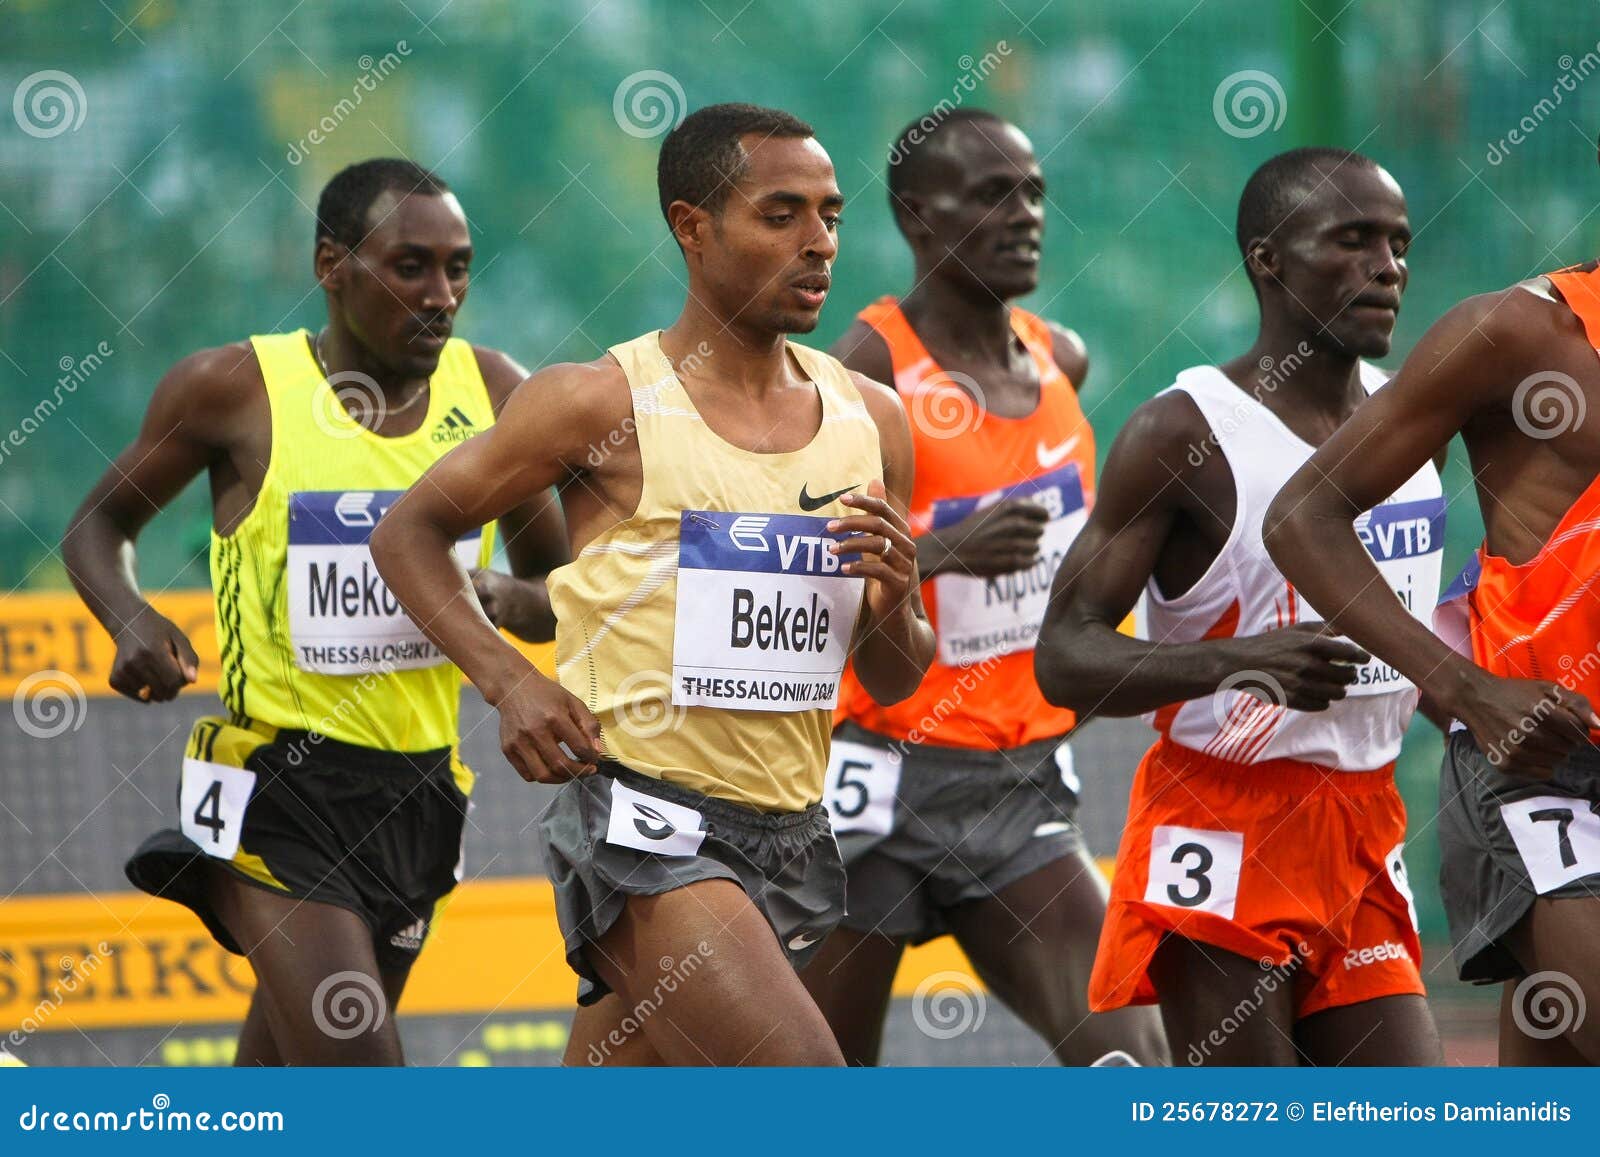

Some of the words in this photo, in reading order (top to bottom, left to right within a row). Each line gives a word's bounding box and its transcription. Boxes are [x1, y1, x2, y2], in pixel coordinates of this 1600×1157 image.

[776, 534, 839, 573] VTB
[1374, 517, 1431, 558] VTB
[308, 561, 406, 618] Meko
[731, 588, 829, 653] Bekele
[682, 677, 812, 702] THESSALONIKI
[194, 779, 225, 844] 4
[833, 760, 872, 818] 5
[1528, 808, 1578, 869] 7
[1167, 842, 1213, 907] 3
